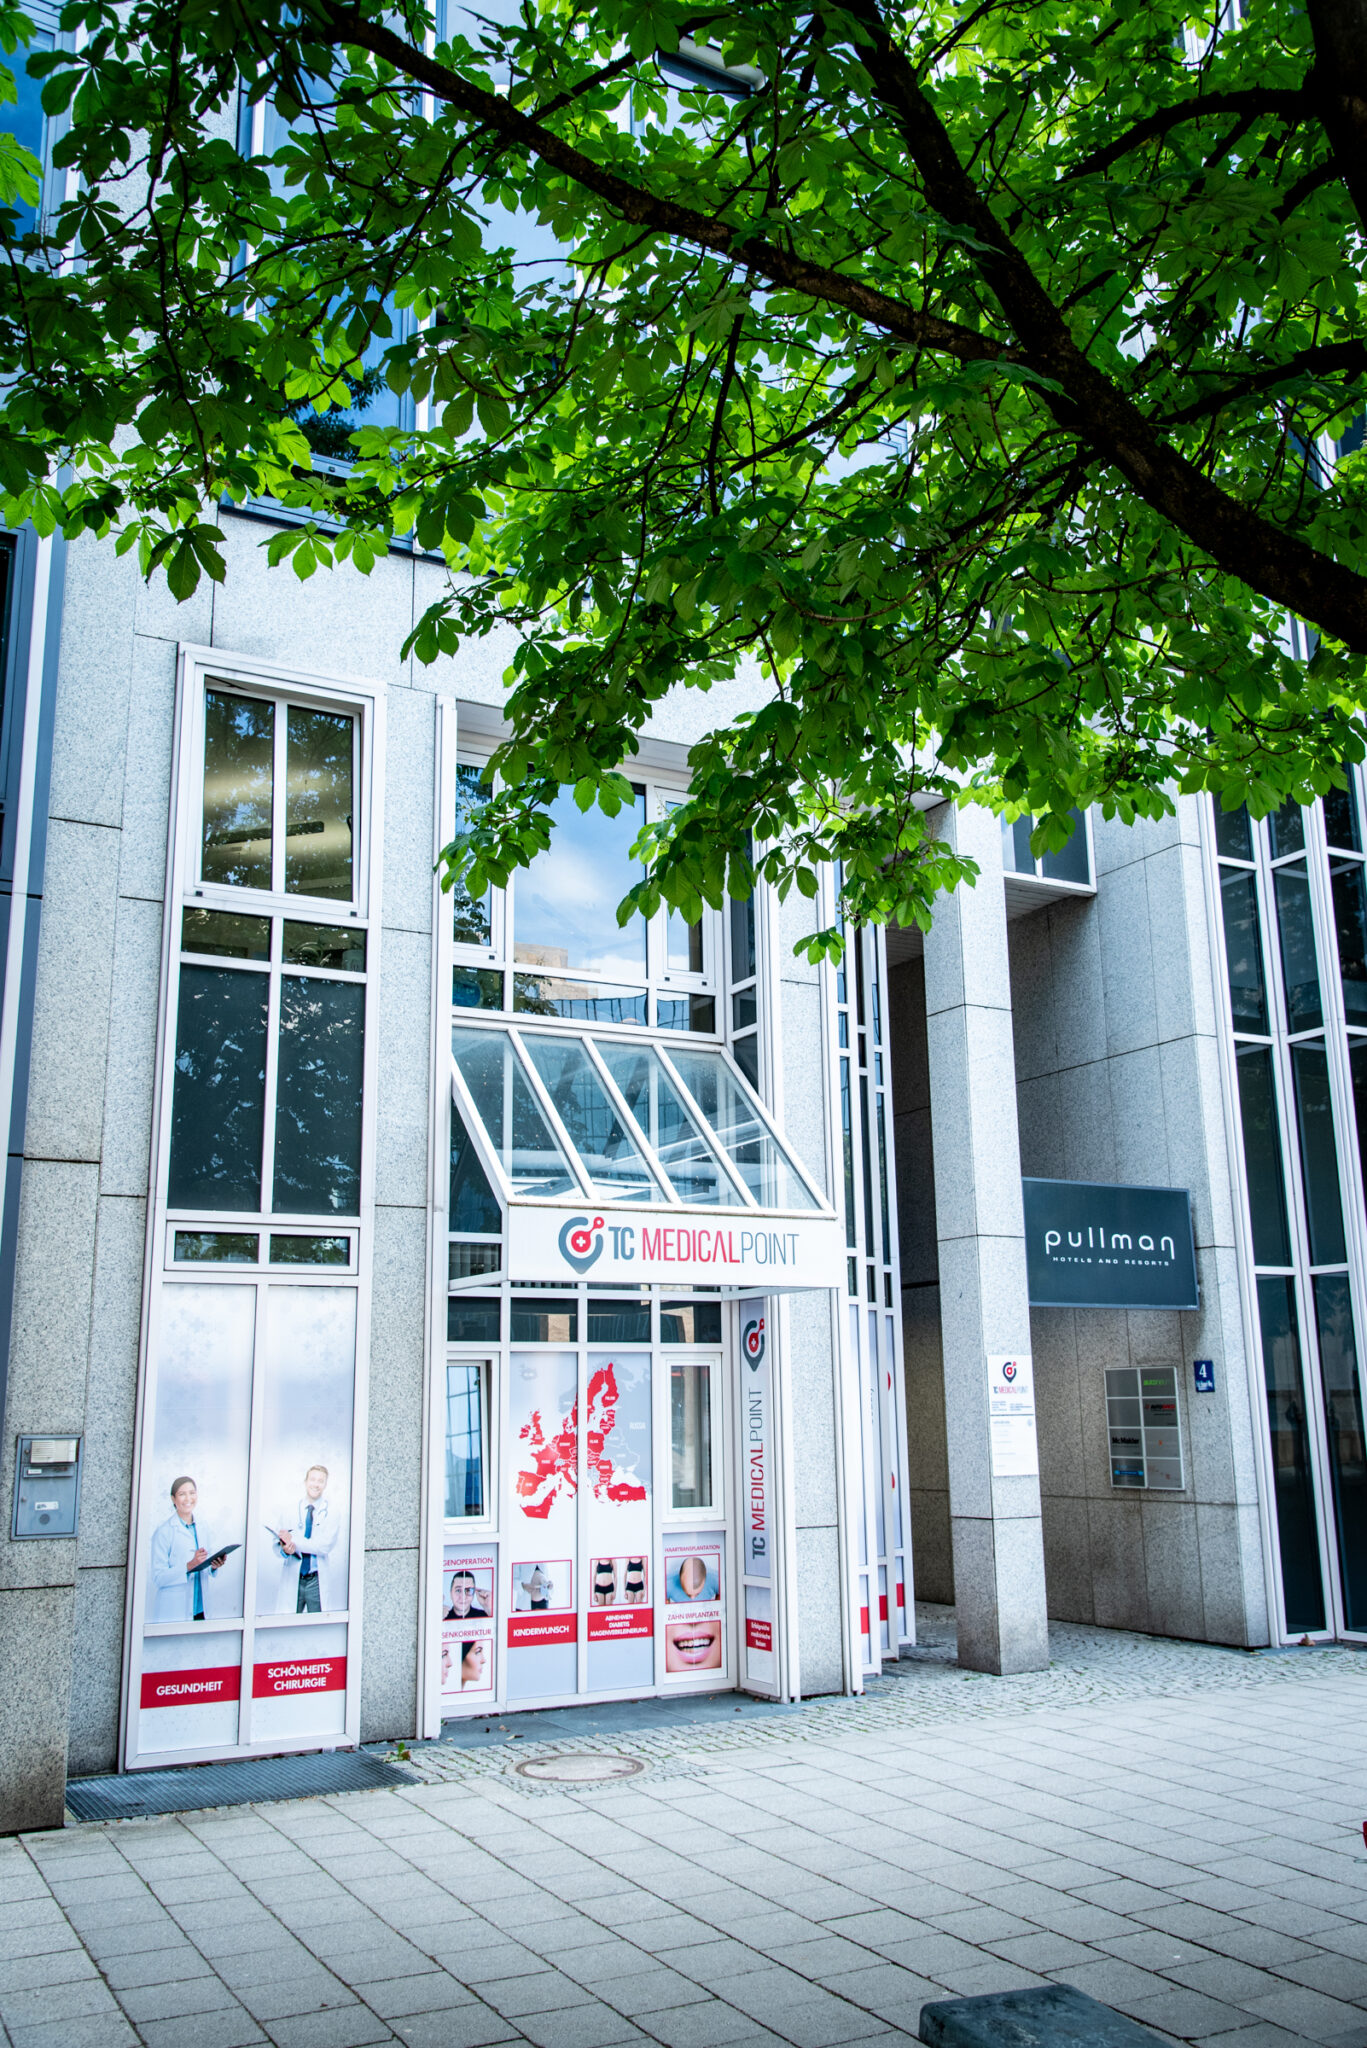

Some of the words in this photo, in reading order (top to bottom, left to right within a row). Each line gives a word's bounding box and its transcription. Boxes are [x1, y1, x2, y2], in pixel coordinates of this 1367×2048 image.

[608, 1226, 635, 1260] TC
[642, 1227, 800, 1266] MEDICALPOINT
[1045, 1226, 1176, 1260] pullman
[1124, 1259, 1170, 1267] RESORTS
[1198, 1363, 1208, 1378] 4
[749, 1388, 765, 1531] MEDICALPOINT
[752, 1536, 765, 1560] TC
[605, 1613, 634, 1621] ABNEHMEN
[685, 1610, 720, 1619] IMPLANTATE
[513, 1625, 570, 1637] KINDERWUNSCH
[267, 1663, 333, 1678] SCHÖNHEITS-
[156, 1680, 223, 1696] GESUNDHEIT
[273, 1677, 327, 1691] CHIRURGIE
